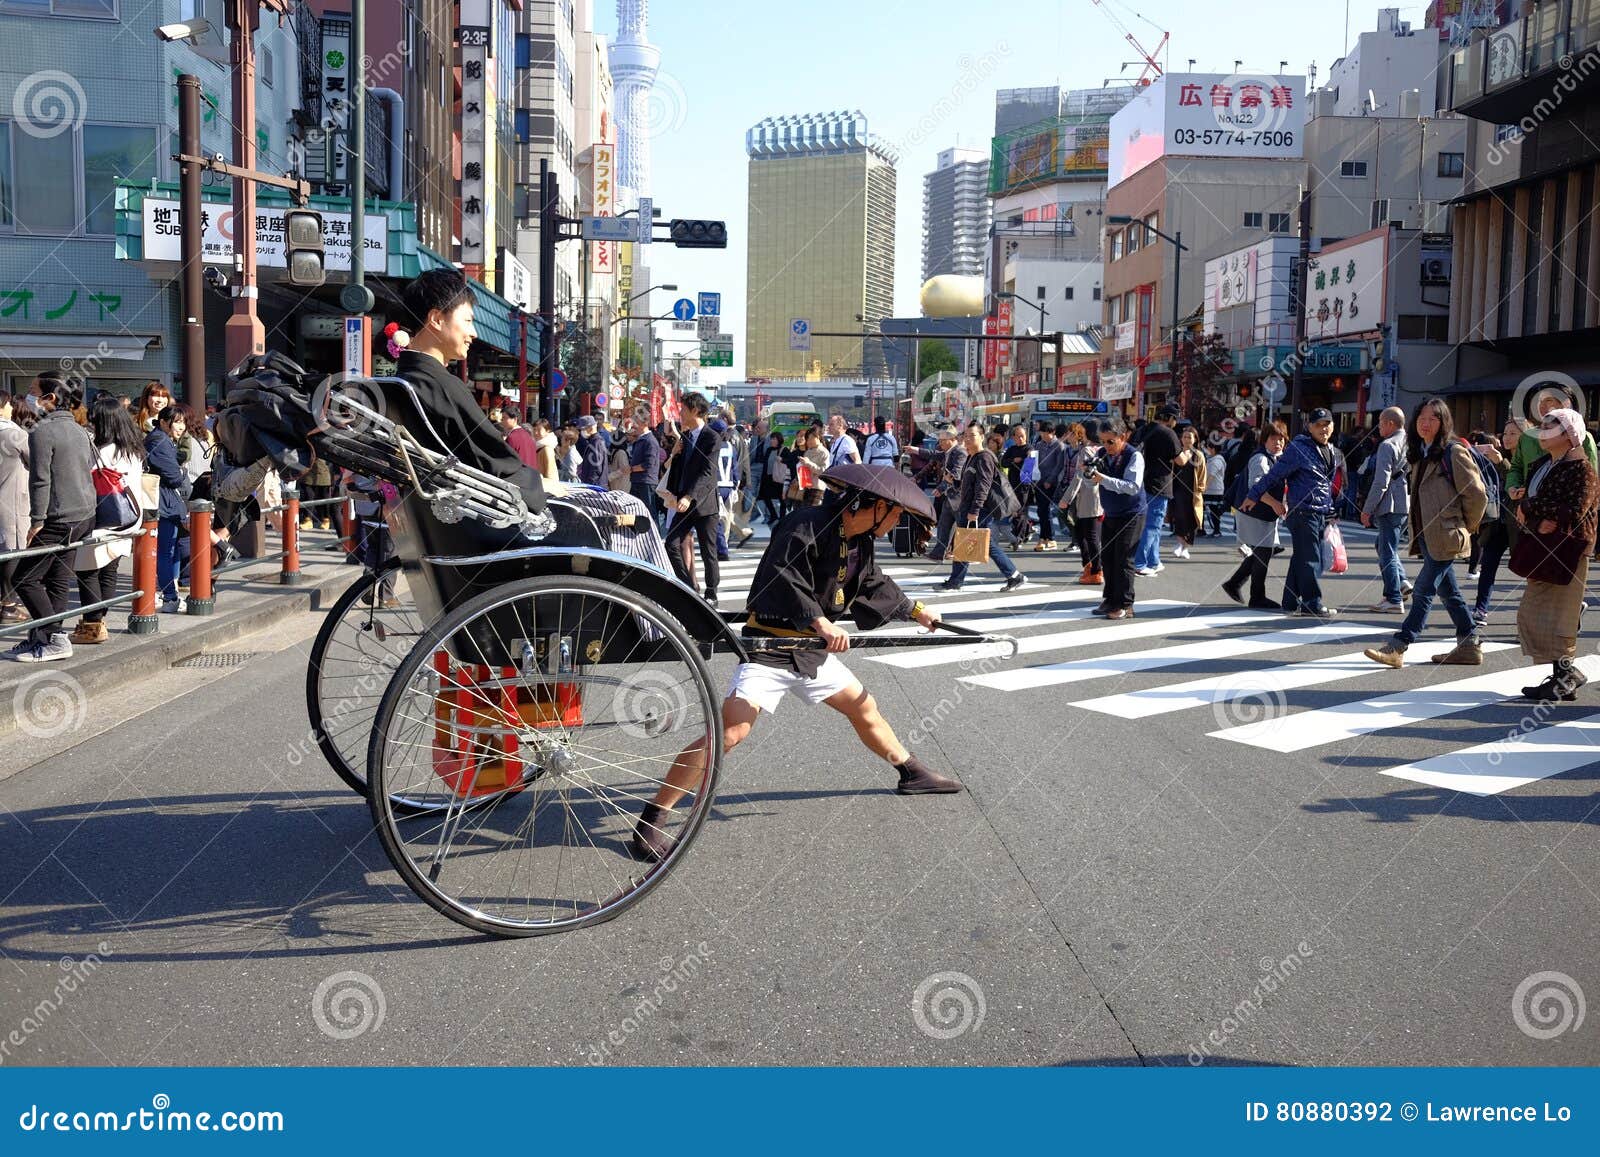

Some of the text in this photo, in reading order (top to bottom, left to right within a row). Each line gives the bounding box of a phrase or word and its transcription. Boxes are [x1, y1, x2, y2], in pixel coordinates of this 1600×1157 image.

[1178, 83, 1293, 109] 広告募集
[1174, 128, 1294, 147] 03-5774-7506
[597, 150, 609, 206] カラオケ
[155, 223, 208, 238] SUBY
